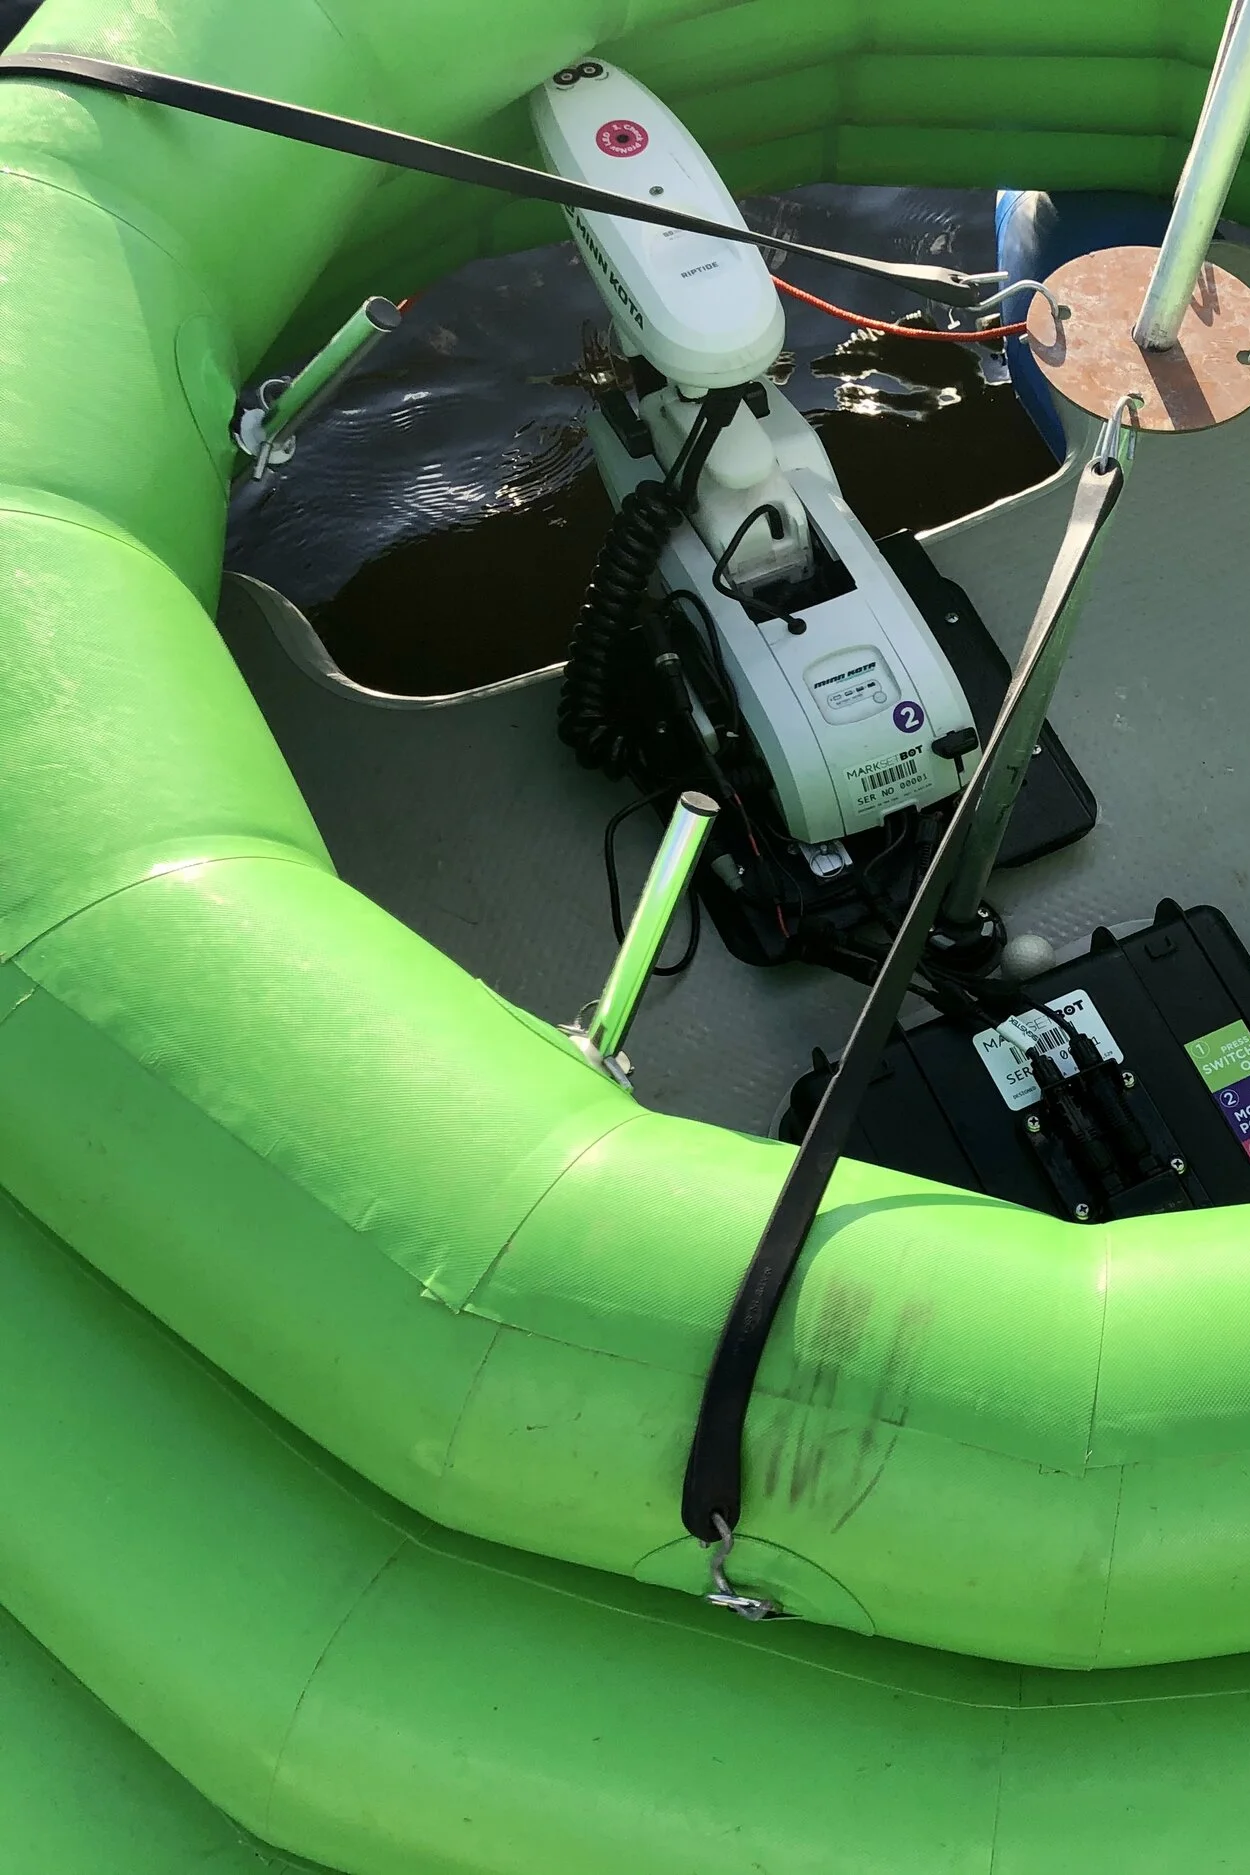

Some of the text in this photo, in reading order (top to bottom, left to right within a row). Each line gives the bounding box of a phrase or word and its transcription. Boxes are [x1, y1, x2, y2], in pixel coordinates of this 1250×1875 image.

[576, 215, 644, 331] MINN KOTA
[680, 261, 719, 279] RIPTIDE
[900, 706, 920, 729] 2
[846, 745, 923, 780] MARKSETBOT
[858, 793, 877, 806] SER
[881, 787, 895, 797] NO
[1220, 1035, 1250, 1054] PRESS
[1006, 1066, 1034, 1085] SER
[1012, 1085, 1037, 1100] DESIGNED
[1223, 1092, 1237, 1106] 2
